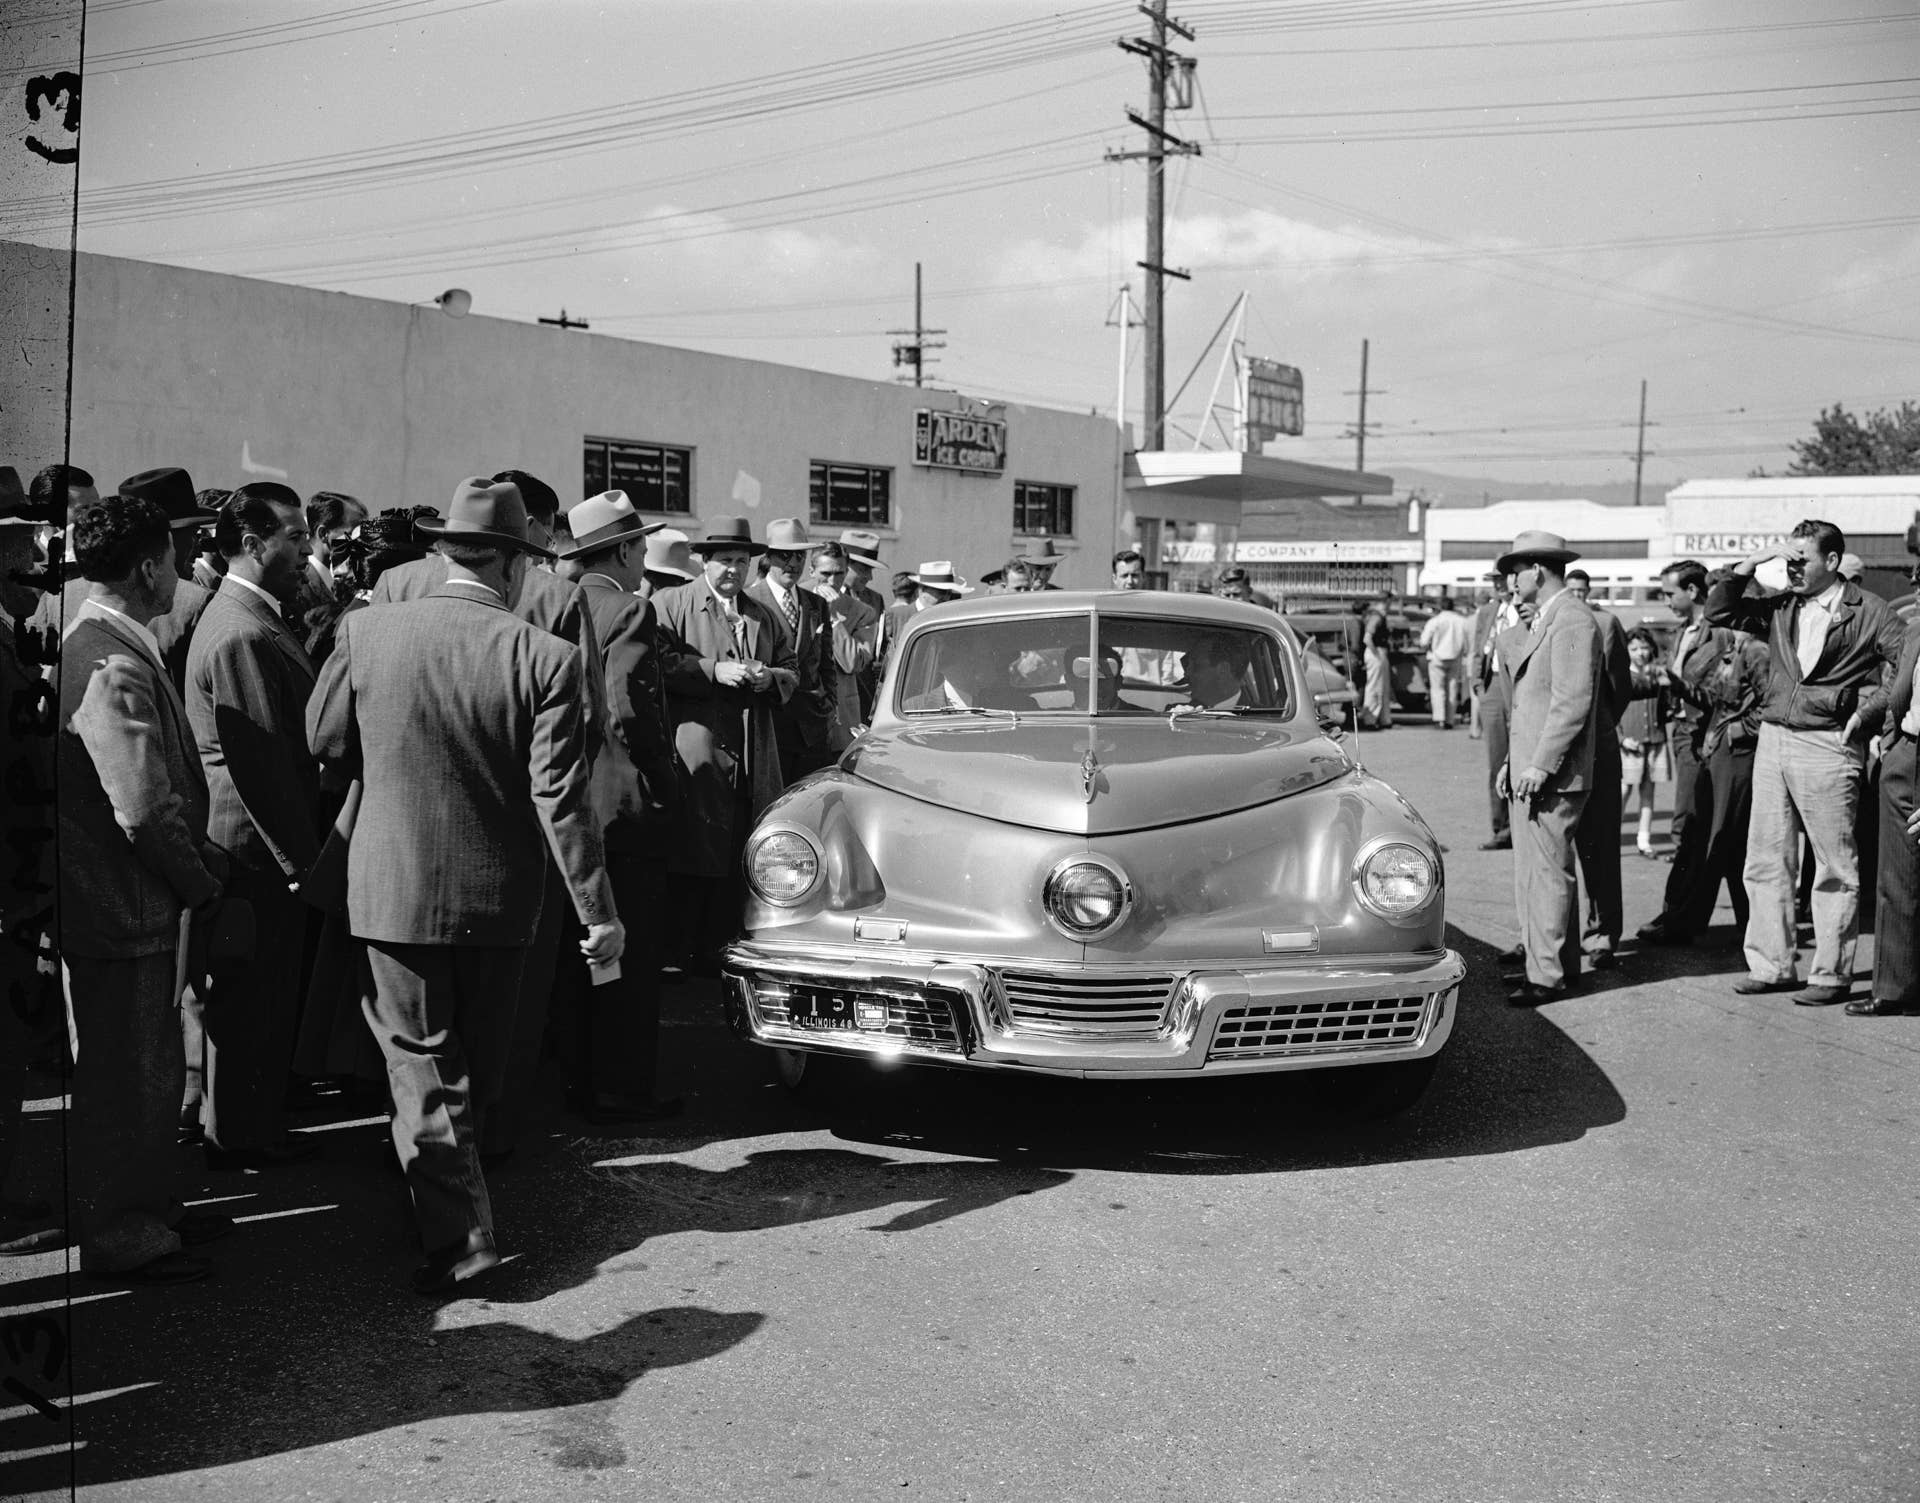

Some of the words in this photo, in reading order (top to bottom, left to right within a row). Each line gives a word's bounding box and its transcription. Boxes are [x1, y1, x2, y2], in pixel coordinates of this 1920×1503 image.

[931, 416, 1002, 456] ARDEN
[937, 445, 955, 464] ICE
[1685, 534, 1727, 550] REAL
[1247, 546, 1315, 558] COMPANY
[802, 1015, 836, 1028] ILLINOIS
[840, 1018, 853, 1030] 48
